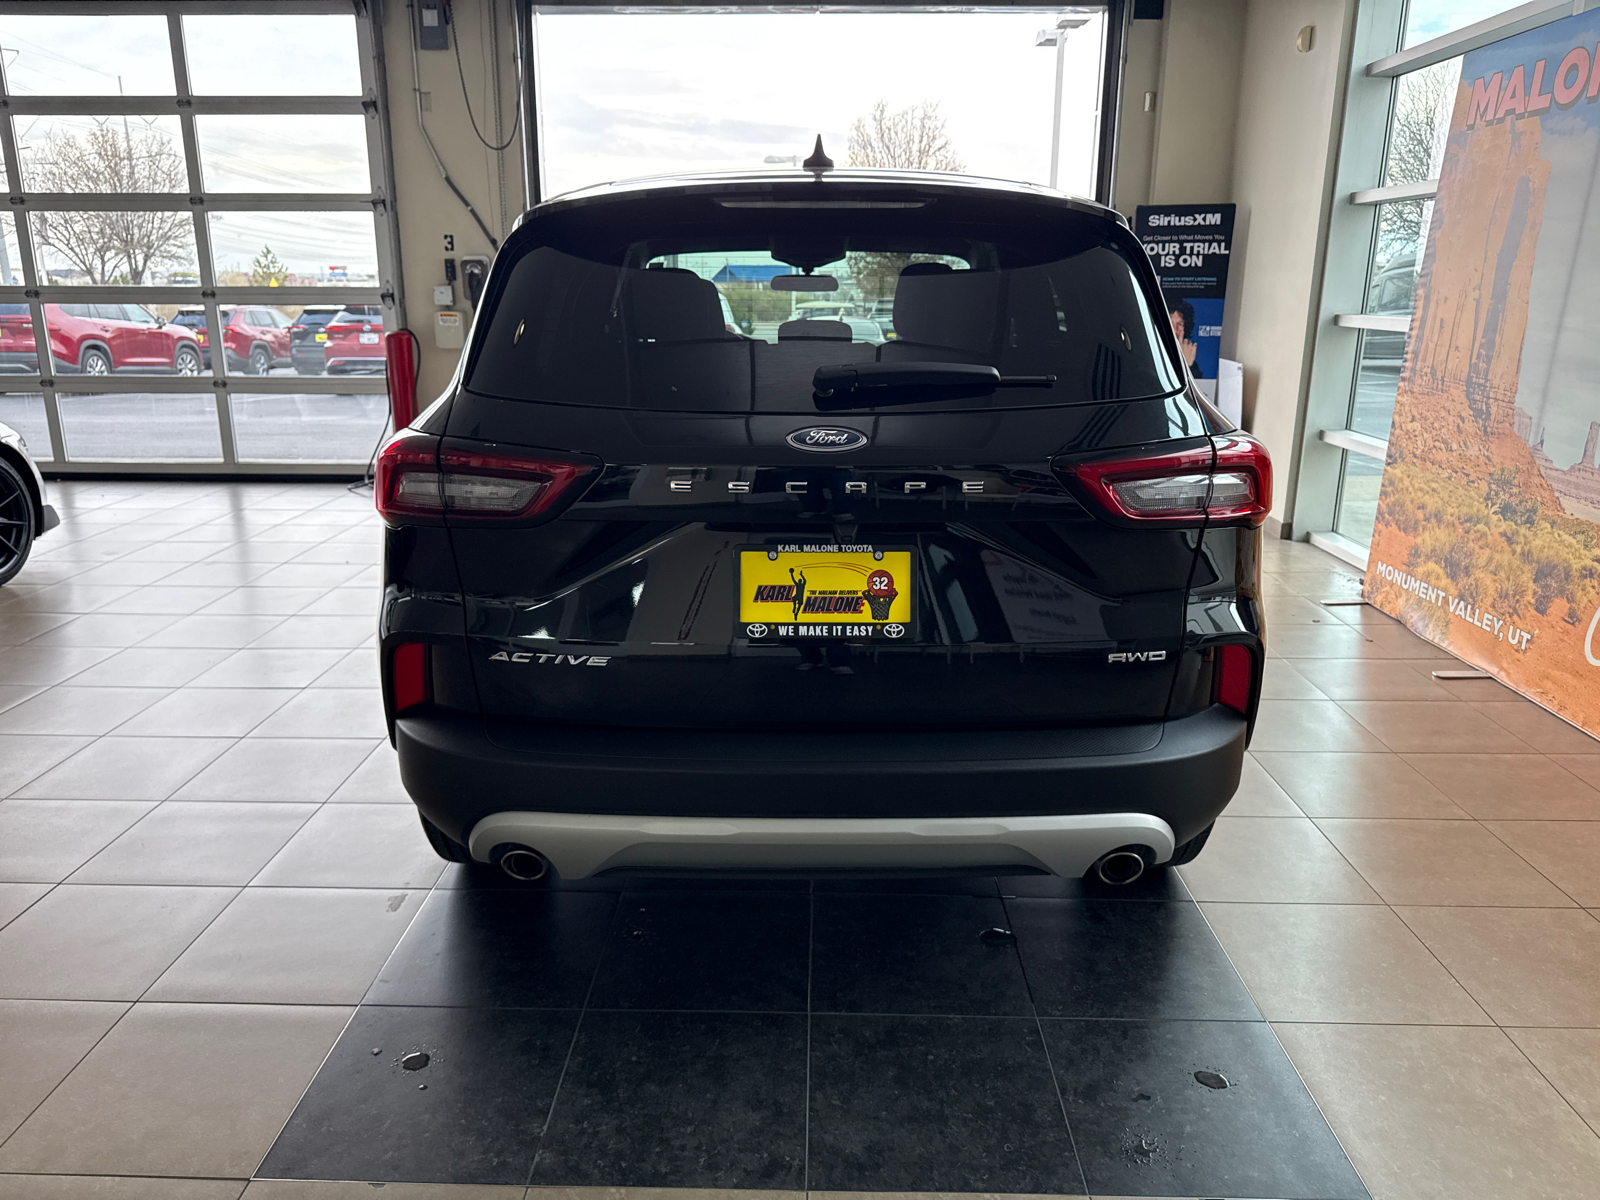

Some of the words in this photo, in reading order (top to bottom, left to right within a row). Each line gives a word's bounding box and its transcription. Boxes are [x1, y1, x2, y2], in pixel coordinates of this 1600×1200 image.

[1148, 213, 1221, 227] SiriusXM
[444, 235, 454, 251] 3
[1183, 242, 1229, 254] TRIAL
[1160, 255, 1176, 267] IS
[1178, 255, 1203, 267] ON
[805, 429, 848, 445] Ford
[670, 480, 984, 494] ESCAPE
[778, 544, 801, 553] KARL
[803, 544, 839, 553] MALONE
[841, 544, 874, 553] TOYOTA
[872, 577, 889, 590] 32
[753, 585, 795, 602] KARL
[802, 596, 865, 614] MALONE
[1376, 560, 1445, 607] MONUMENT
[1448, 595, 1504, 641] VALLEY,
[1507, 625, 1531, 650] UT
[778, 625, 795, 636] WE
[798, 625, 829, 636] MAKE
[832, 625, 843, 636] IT
[846, 625, 874, 636] EASY
[488, 651, 612, 667] ACTIVE
[1107, 650, 1167, 663] AWD
